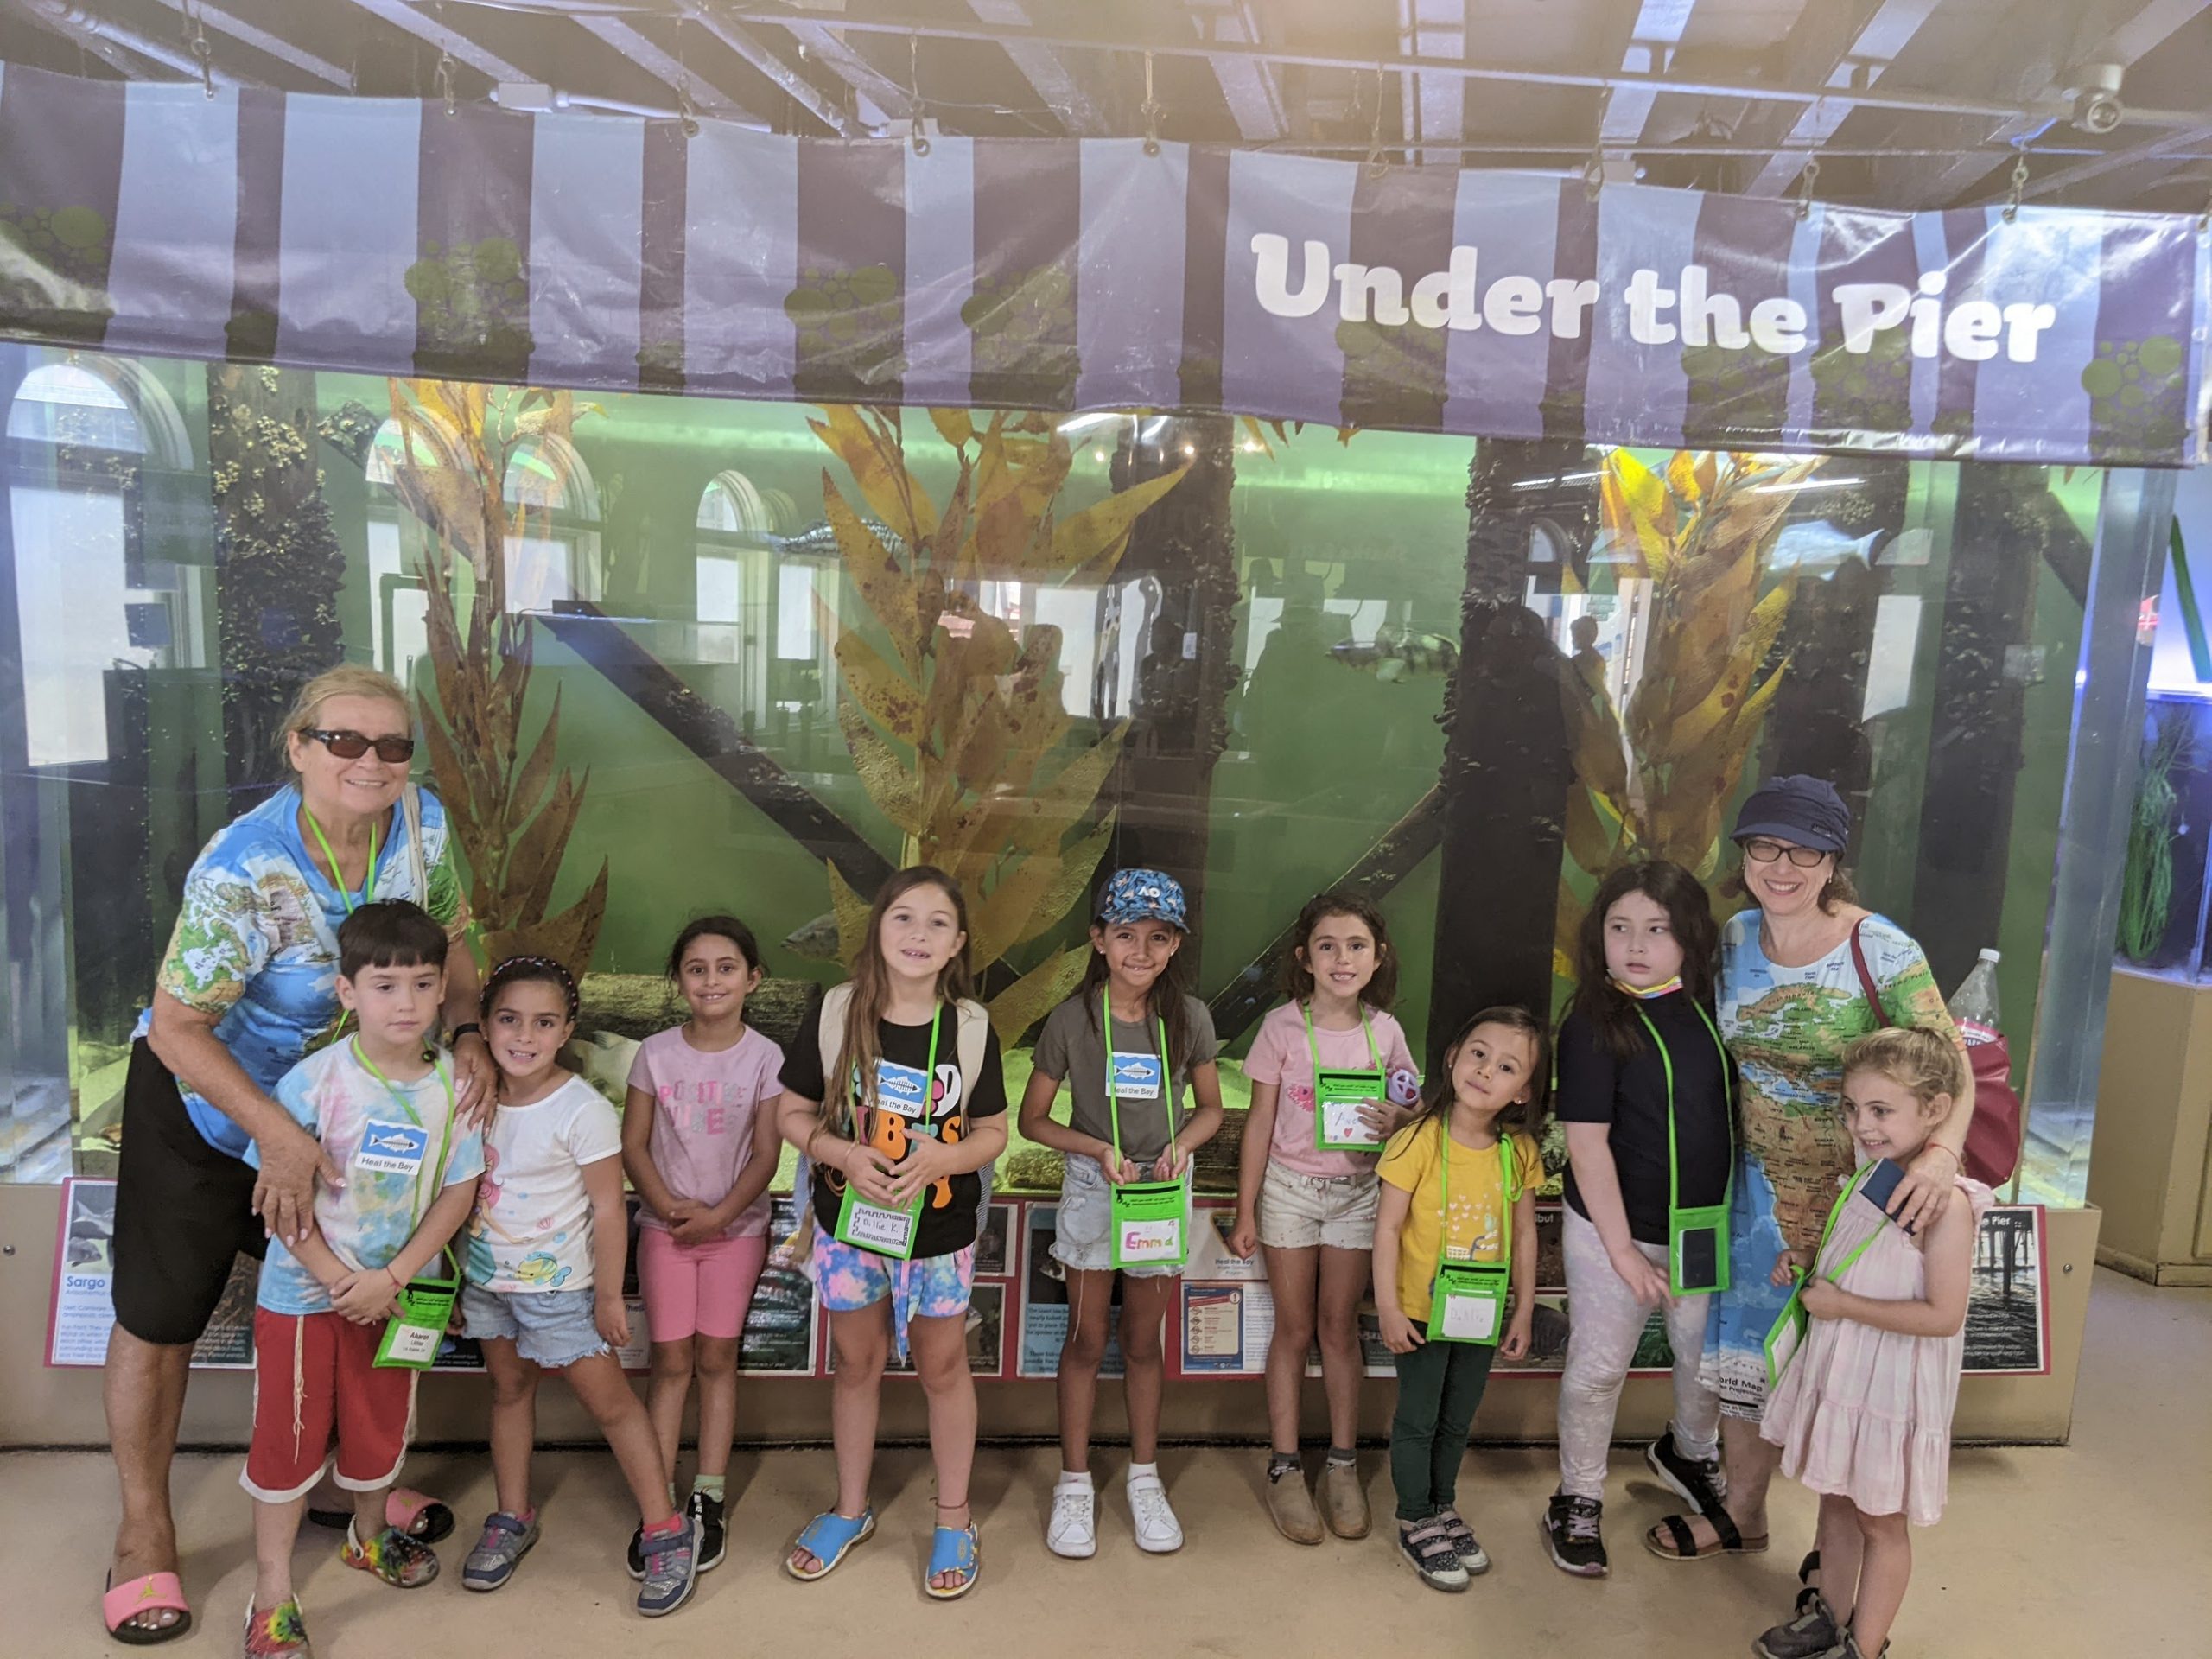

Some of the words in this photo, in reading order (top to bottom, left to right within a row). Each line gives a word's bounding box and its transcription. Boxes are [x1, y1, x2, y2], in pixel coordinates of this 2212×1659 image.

[1251, 233, 1600, 340] Under
[1624, 265, 1807, 353] the
[1833, 270, 2056, 364] Pier
[1141, 1087, 1154, 1096] Bay
[889, 1100, 901, 1110] the
[902, 1103, 917, 1115] Bay
[361, 1156, 382, 1167] Heal
[384, 1160, 397, 1169] the
[397, 1162, 415, 1172] Bay
[1992, 1216, 2011, 1226] Pier
[1125, 1231, 1173, 1249] Emma
[67, 1275, 105, 1290] Sargo
[1719, 1376, 1738, 1386] orld
[1741, 1380, 1763, 1392] Map
